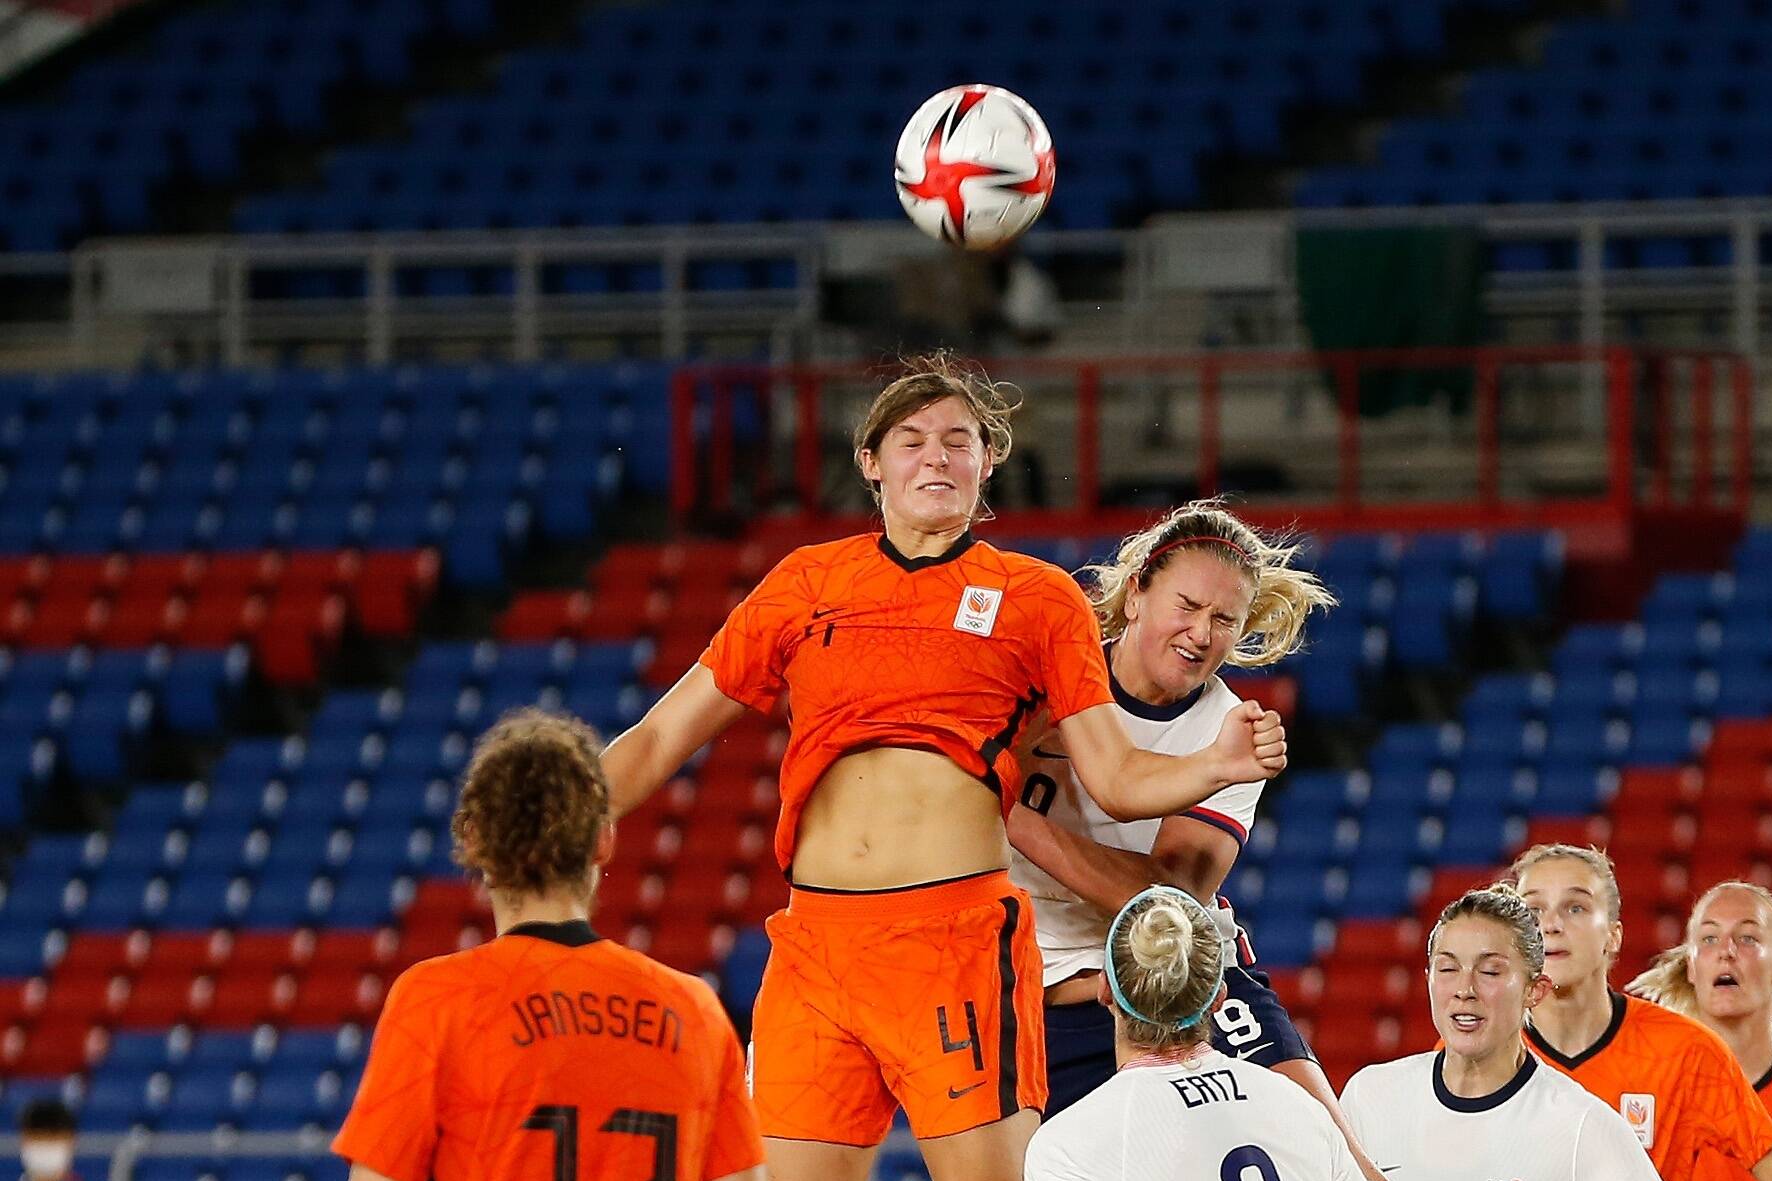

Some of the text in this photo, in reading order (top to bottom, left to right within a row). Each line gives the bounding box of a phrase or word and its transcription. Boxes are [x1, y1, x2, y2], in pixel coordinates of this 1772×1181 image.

[512, 991, 682, 1054] JANSSEN
[936, 1000, 985, 1071] 4
[1213, 998, 1262, 1047] 9
[1168, 1069, 1248, 1109] ERTZ
